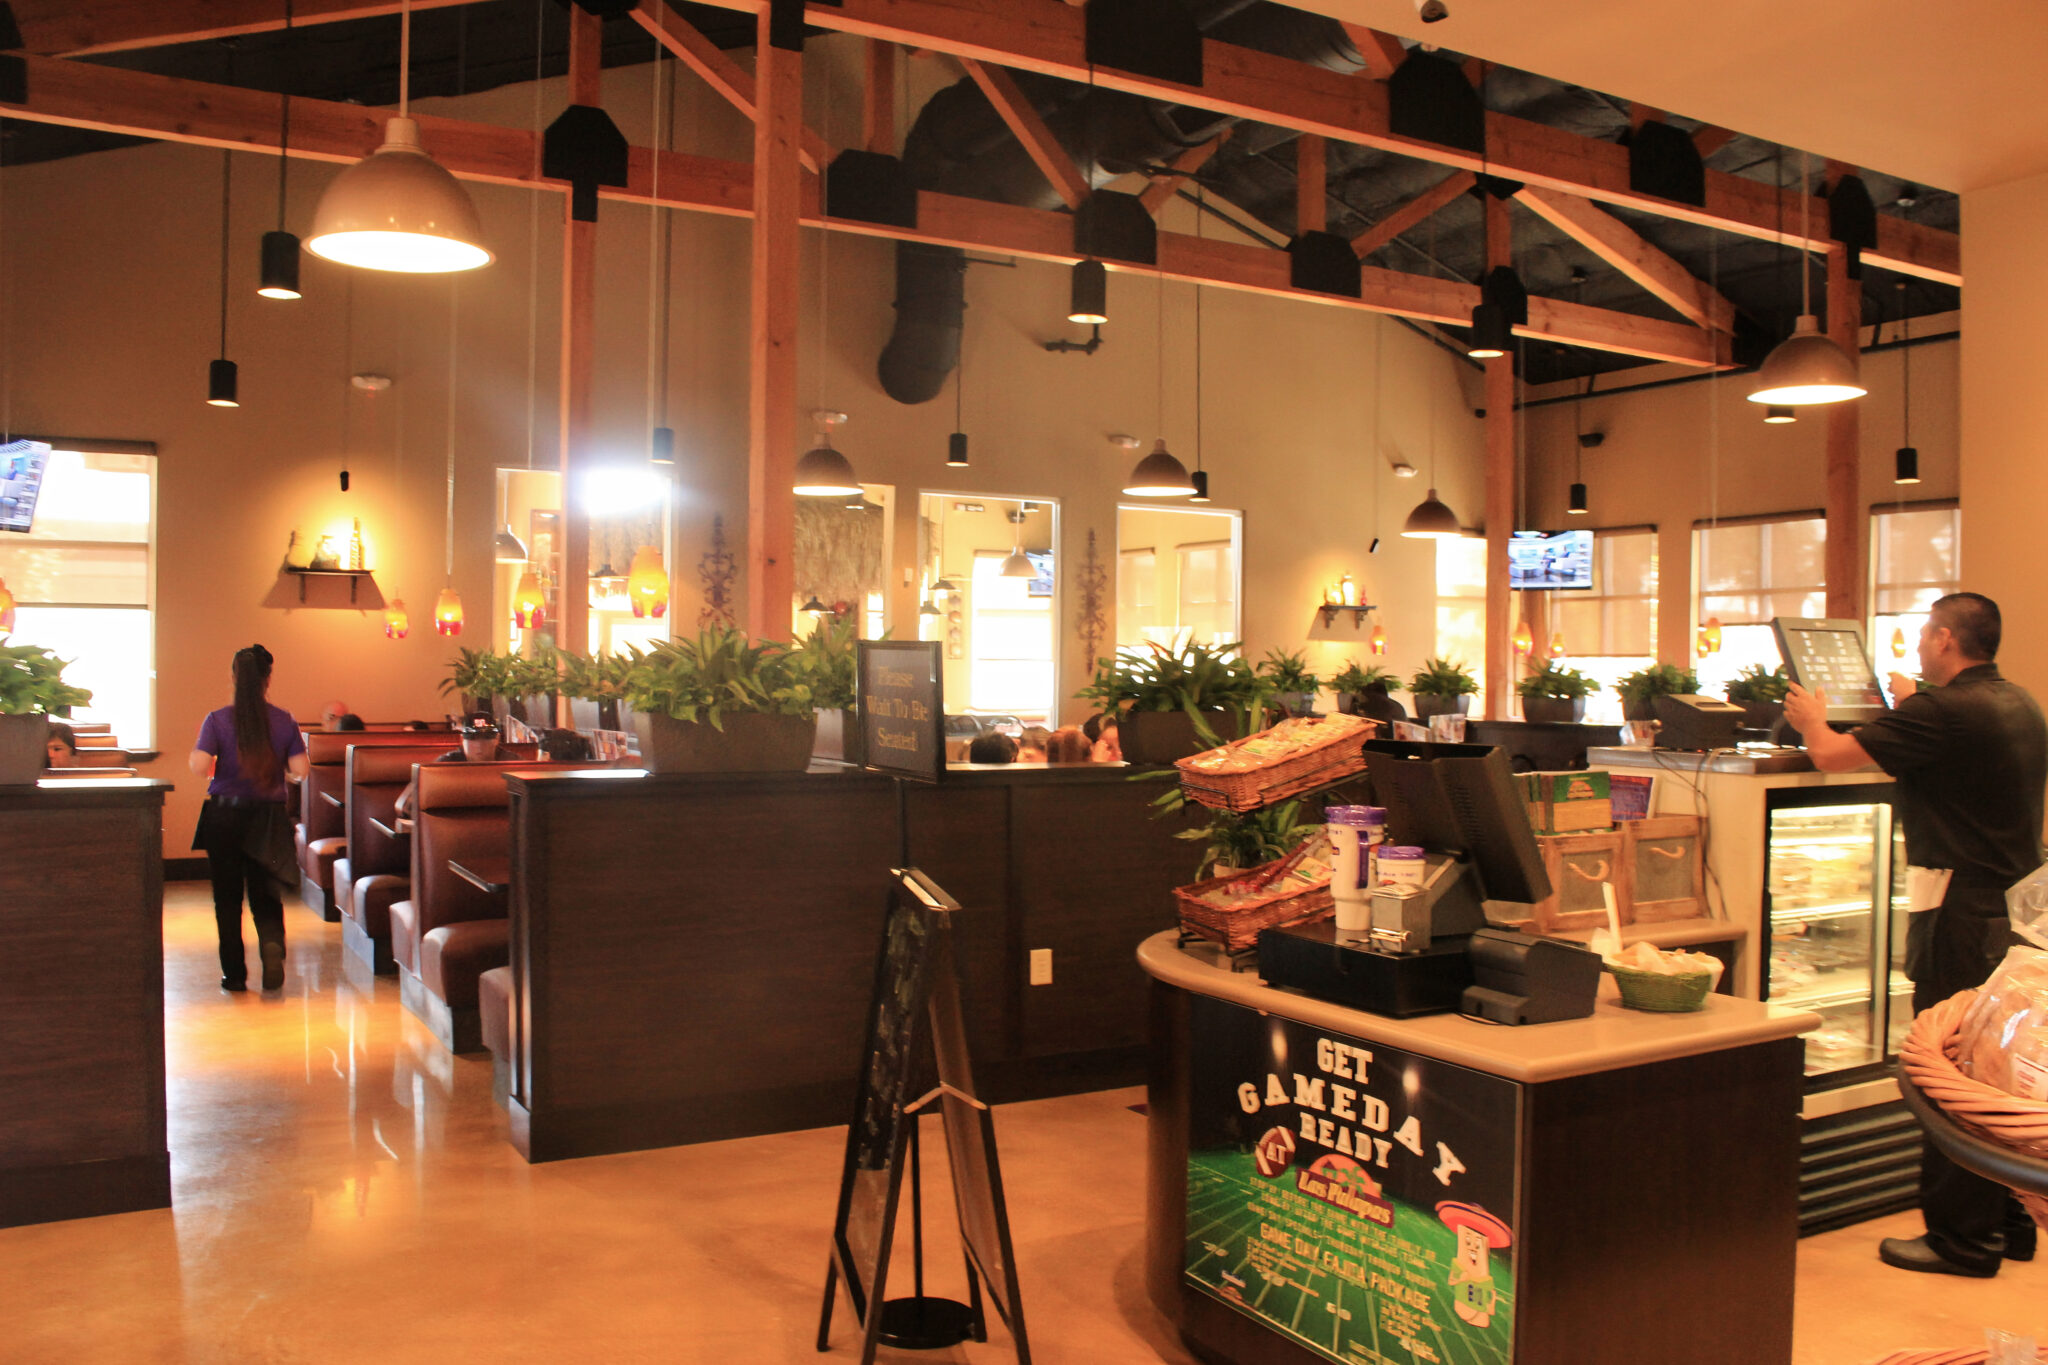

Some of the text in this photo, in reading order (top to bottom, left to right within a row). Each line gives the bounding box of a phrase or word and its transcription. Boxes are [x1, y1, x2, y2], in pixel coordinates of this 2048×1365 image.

[878, 666, 914, 688] Please
[866, 695, 929, 722] Wait To Be
[878, 727, 918, 752] Seated
[1317, 1037, 1373, 1085] GET
[1266, 1141, 1288, 1166] AT
[1299, 1111, 1393, 1169] READY
[1260, 1222, 1293, 1251] GAME
[1295, 1237, 1320, 1262] DAY
[1324, 1250, 1367, 1284] FAJITA
[1370, 1270, 1432, 1314] PACKAGE
